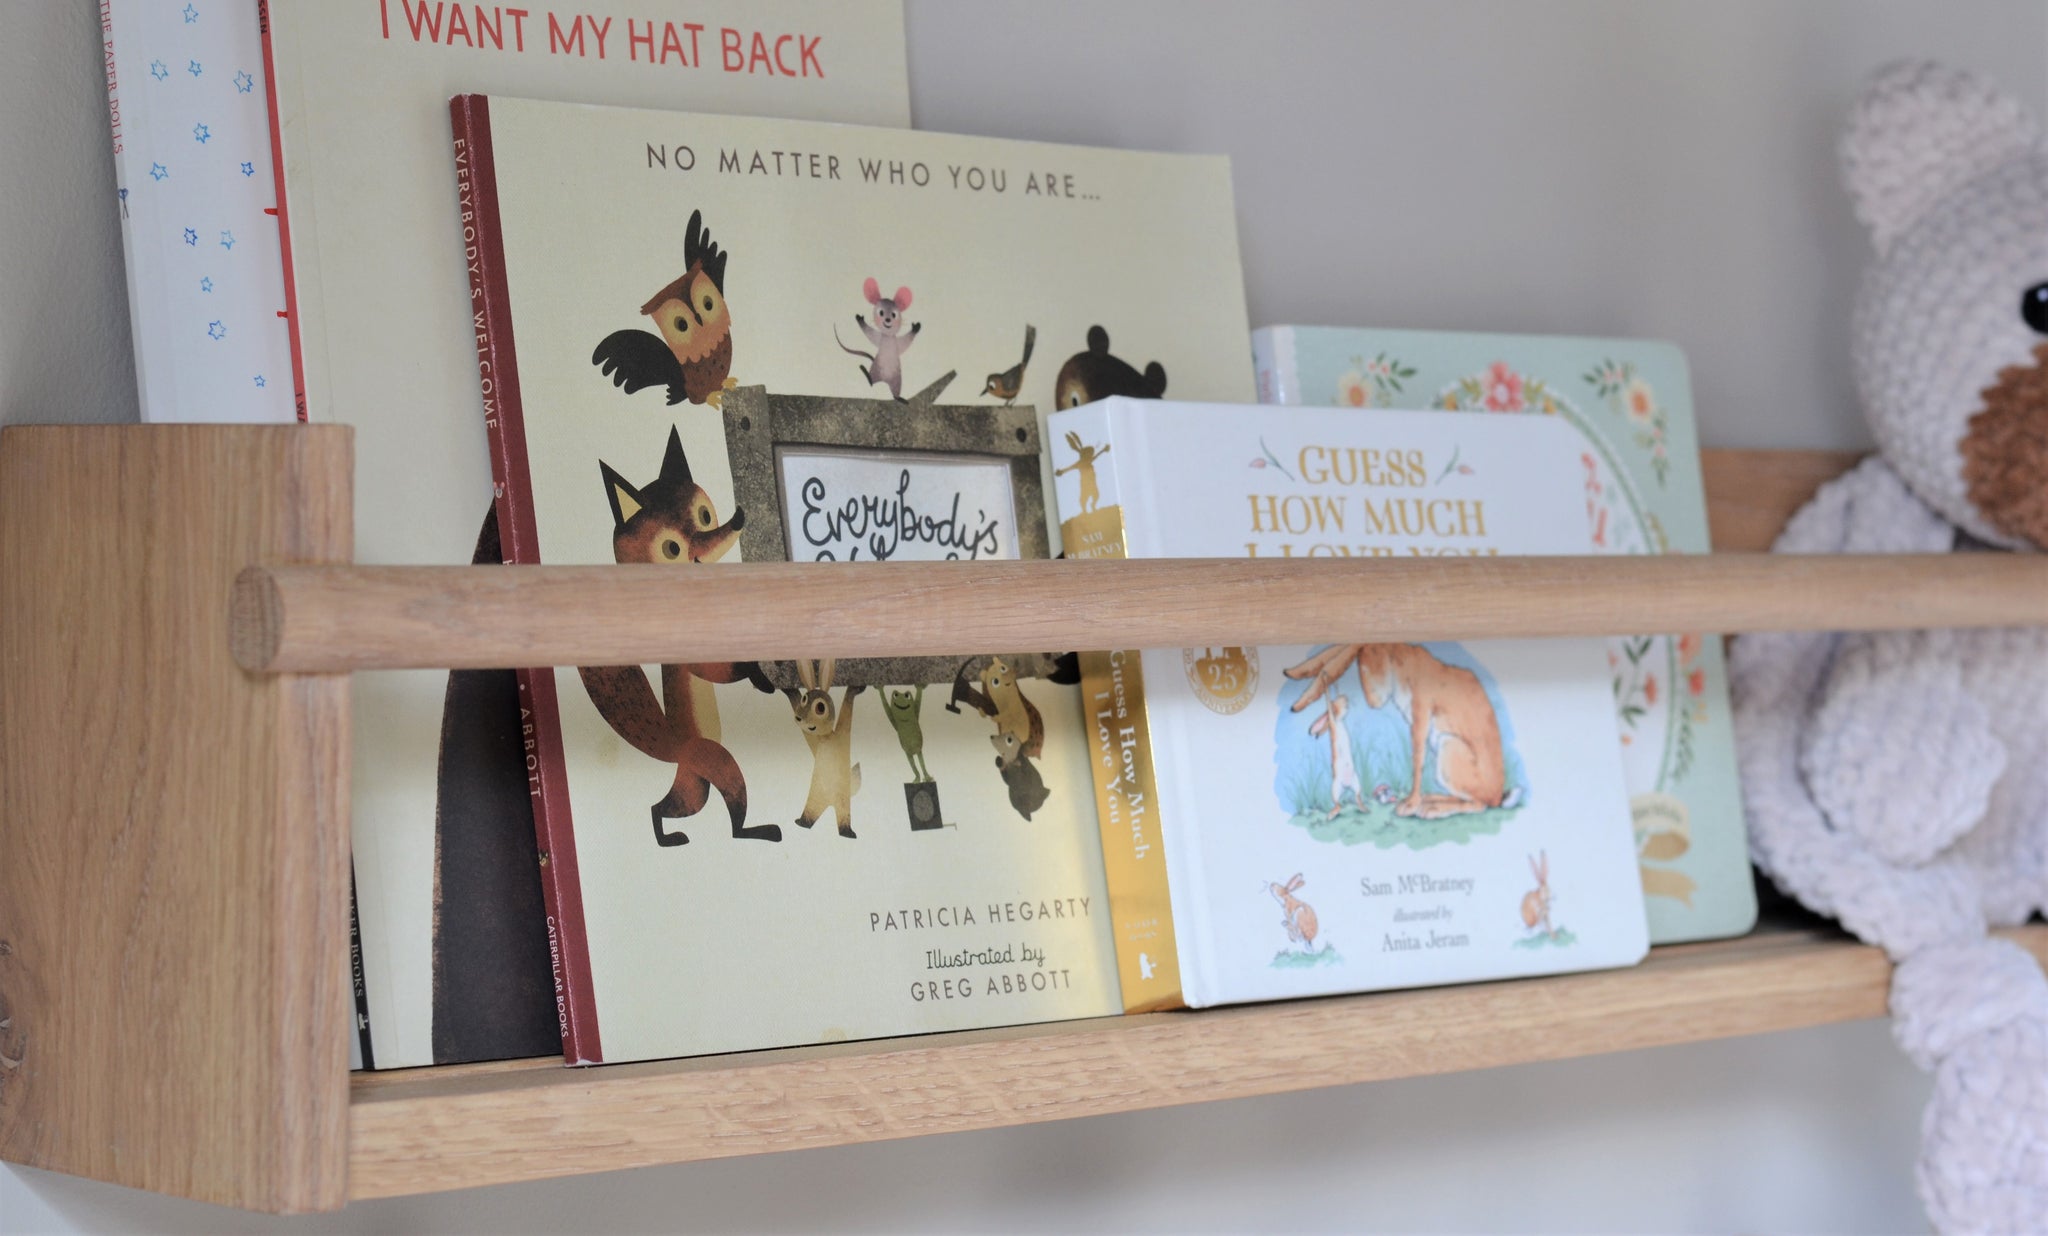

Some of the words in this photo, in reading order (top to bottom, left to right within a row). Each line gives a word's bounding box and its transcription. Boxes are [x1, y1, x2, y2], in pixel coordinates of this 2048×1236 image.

[380, 0, 389, 39] I
[402, 0, 528, 52] WANT
[548, 12, 612, 59] MY
[628, 18, 704, 68] HAT
[720, 28, 824, 78] BACK
[104, 40, 117, 92] PAPER
[109, 99, 124, 155] DOLLS
[646, 142, 695, 171] NO
[719, 148, 842, 181] MATTER
[858, 157, 930, 187] WHO
[948, 165, 1007, 195] YOU
[454, 138, 482, 299] EVERYBODY'S
[474, 310, 497, 430] WELCOME
[1298, 445, 1428, 488] GUESS
[802, 469, 998, 560] Everybody's
[1247, 494, 1347, 535] HOW
[1363, 498, 1488, 537] MUCH
[1095, 691, 1110, 701] I
[520, 707, 541, 798] ABBOTT
[1097, 709, 1113, 768] Love
[1110, 649, 1127, 719] Guess
[1119, 725, 1137, 785] How
[1128, 792, 1151, 860] Much
[1106, 774, 1123, 824] You
[1360, 877, 1392, 897] Sam
[870, 906, 976, 932] PATRICIA
[988, 897, 1090, 924] HEGARTY
[1382, 931, 1421, 952] Anita
[1425, 929, 1469, 950] Jeram
[351, 944, 363, 998] BOOKS
[547, 916, 562, 992] CATERPILLAR
[557, 996, 569, 1038] BOOKS
[926, 943, 1015, 970] Illustrated
[1020, 942, 1046, 968] by
[911, 978, 972, 1002] GREG
[987, 969, 1071, 996] ABBOTT
